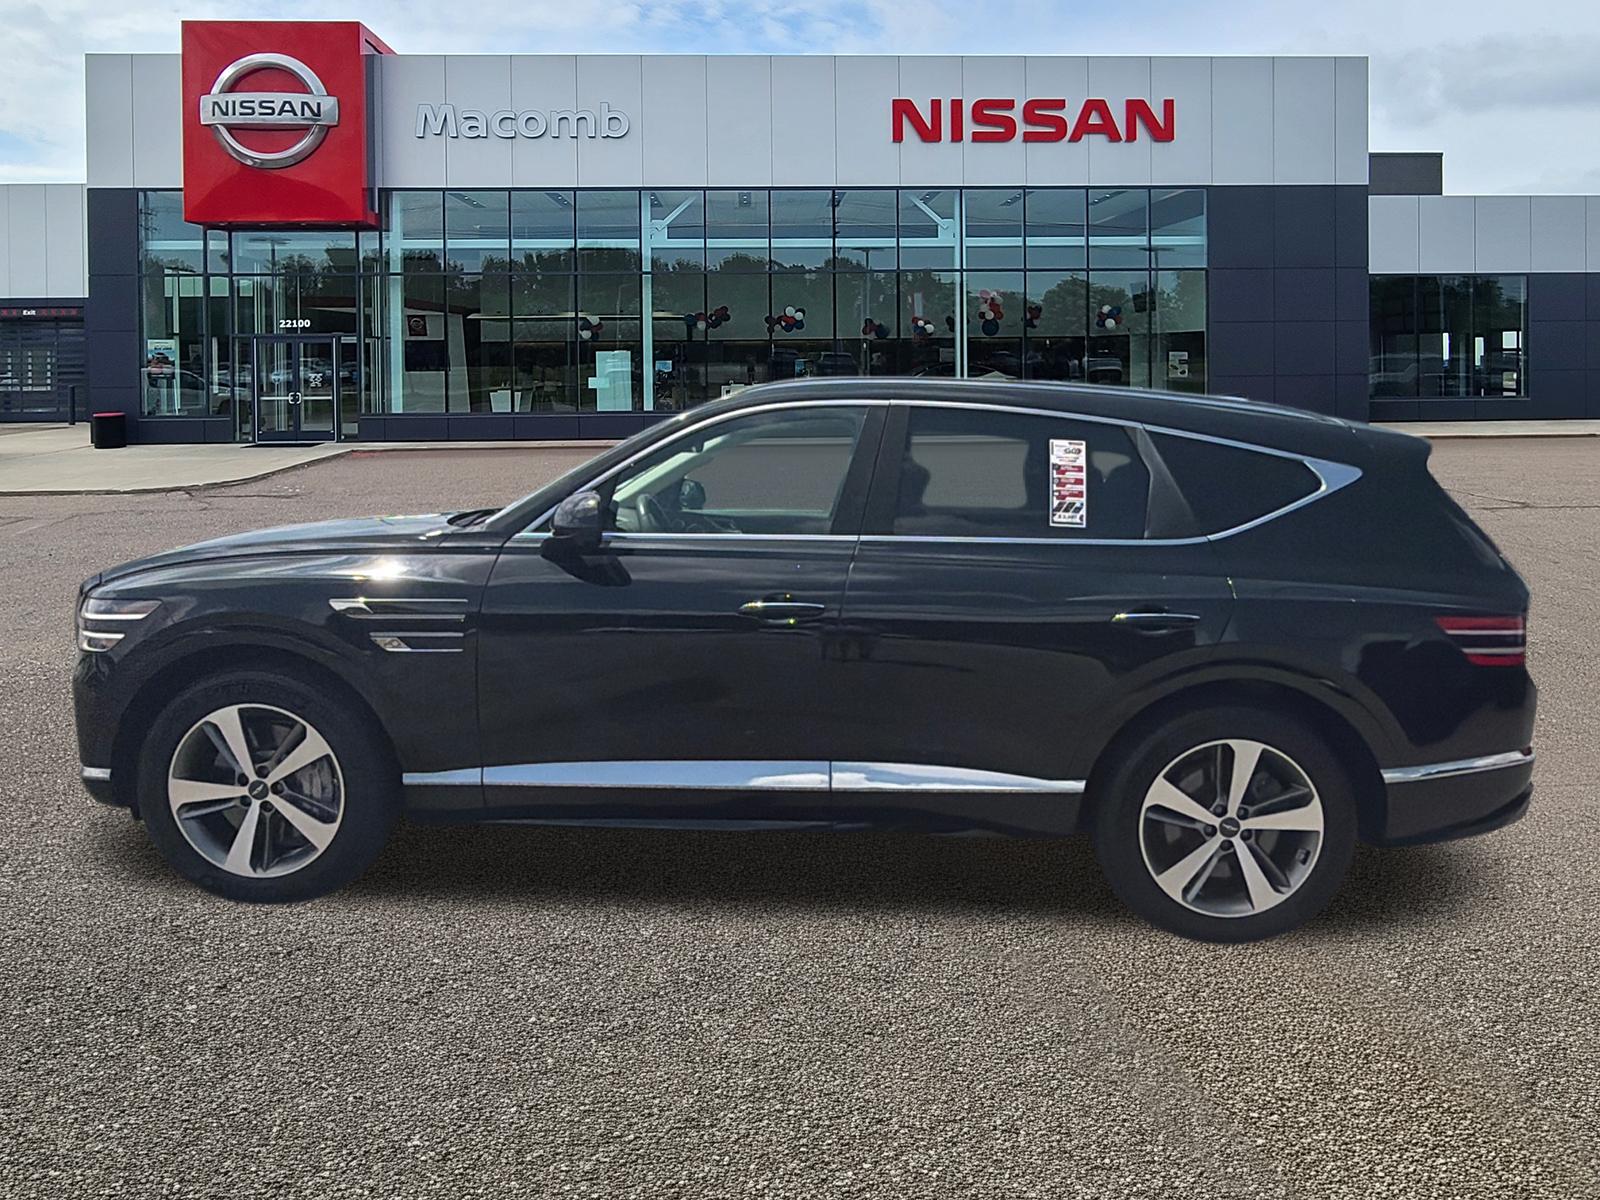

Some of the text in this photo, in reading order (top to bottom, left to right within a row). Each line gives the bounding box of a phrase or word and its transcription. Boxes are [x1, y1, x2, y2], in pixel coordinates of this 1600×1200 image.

[211, 99, 322, 118] NISSAN
[415, 102, 631, 139] Macomb
[892, 98, 1175, 142] NISSAN
[279, 319, 311, 328] 22100
